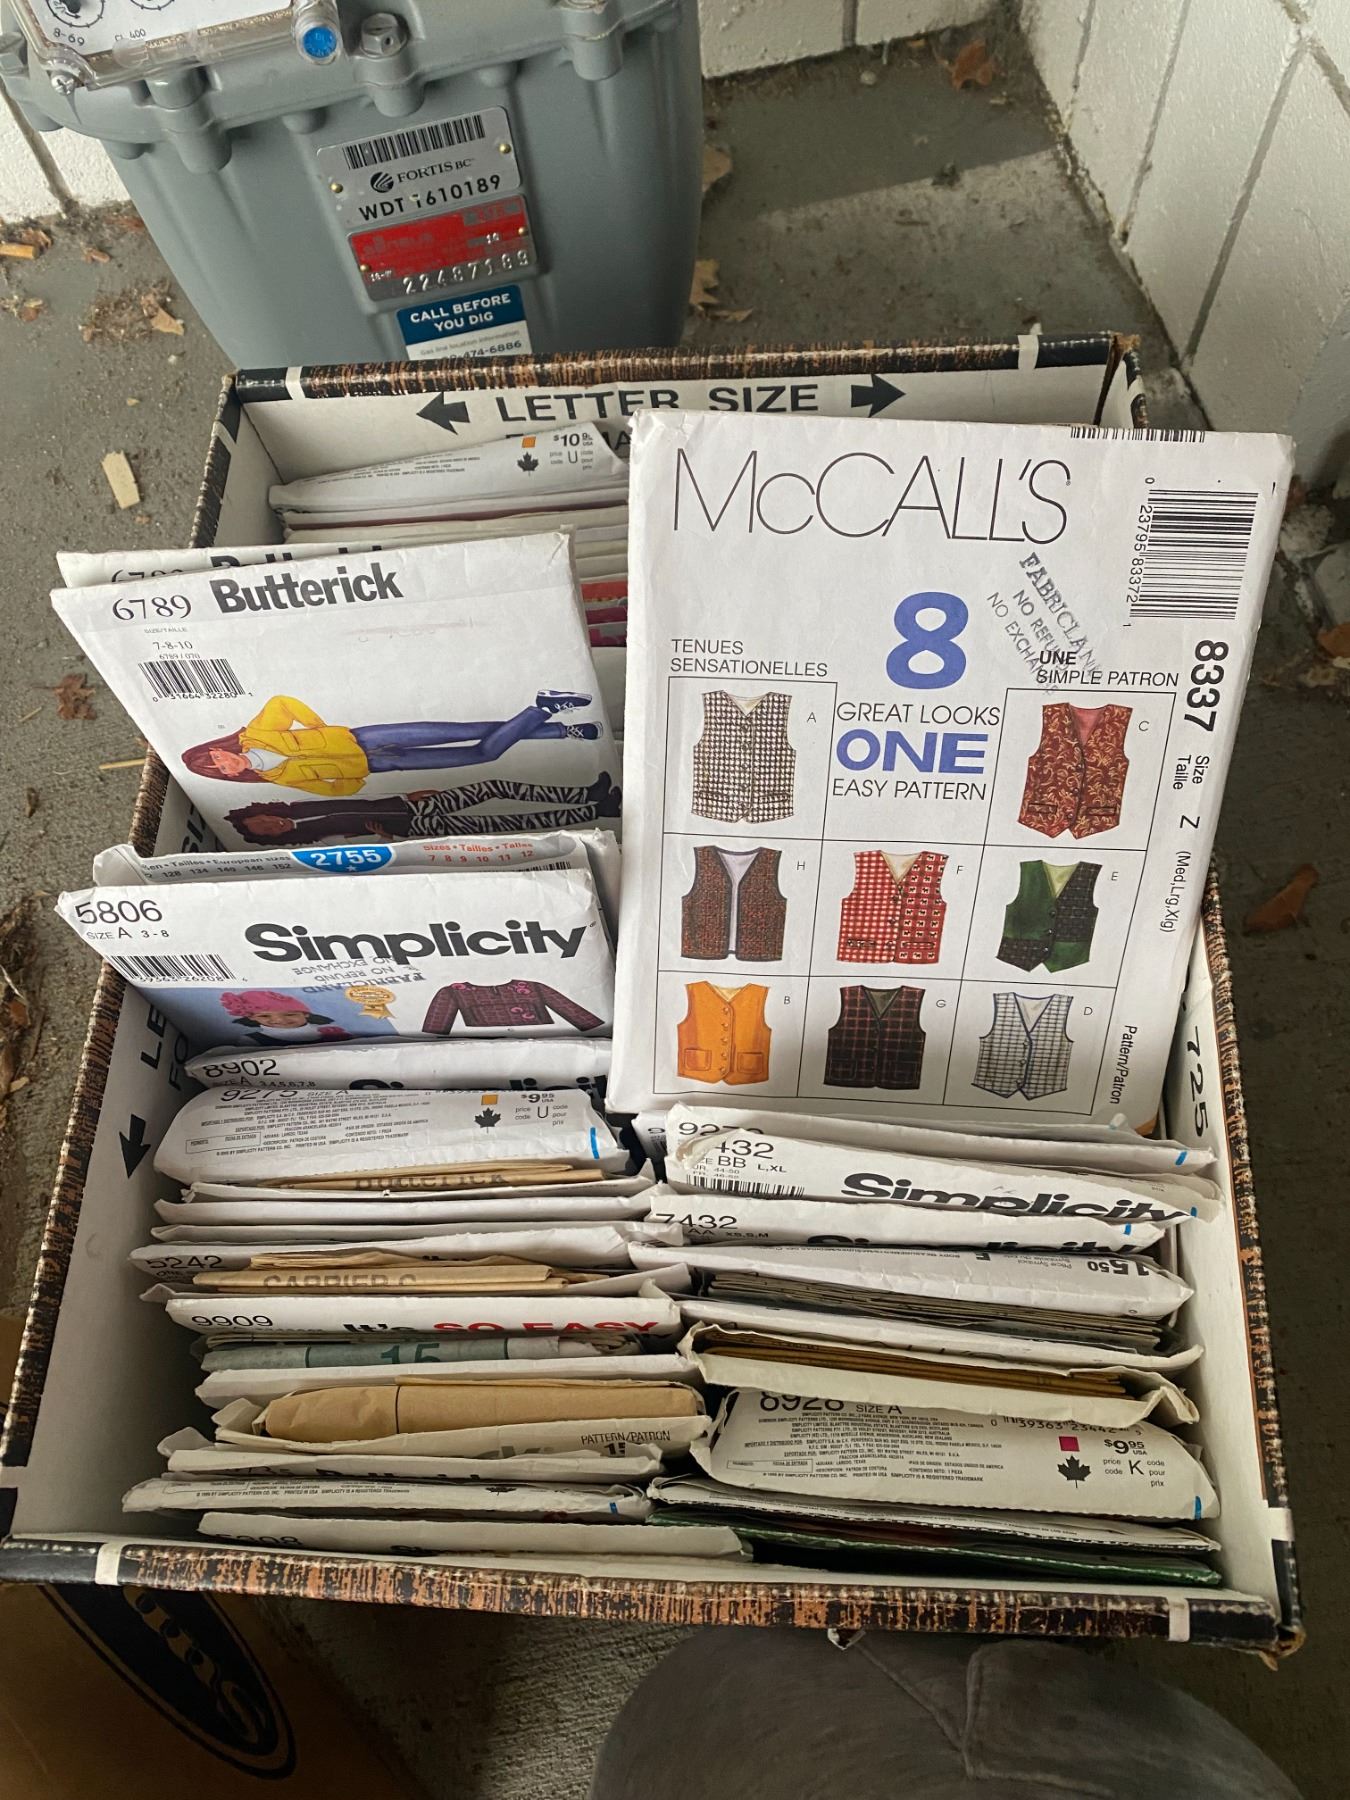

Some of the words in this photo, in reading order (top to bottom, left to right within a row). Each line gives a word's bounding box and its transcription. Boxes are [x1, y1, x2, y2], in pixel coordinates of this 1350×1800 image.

[53, 28, 85, 46] 8-69
[129, 28, 146, 39] 400
[397, 162, 453, 184] FORTIS
[455, 159, 473, 171] BC
[358, 197, 405, 221] WDT
[410, 306, 450, 323] CALL
[452, 293, 511, 318] BEFORE
[434, 317, 465, 332] YOU
[469, 311, 494, 325] DIG
[496, 388, 680, 422] LETTER
[708, 384, 819, 413] SIZE
[567, 450, 578, 464] U
[1133, 505, 1153, 551] 23795
[1126, 557, 1144, 603] 83372
[112, 594, 192, 621] 6789
[209, 562, 404, 615] Butterick
[986, 592, 1009, 617] NO
[1013, 589, 1035, 616] NO
[152, 640, 193, 650] 7-8-10
[671, 638, 744, 655] TENUES
[886, 592, 969, 690] 8
[1039, 650, 1077, 665] UNE
[670, 657, 828, 677] SENSATIONELLES
[1036, 670, 1102, 685] SIMPLE
[1107, 671, 1179, 687] PATRON
[1183, 638, 1229, 732] 8337
[807, 711, 817, 723] A
[836, 701, 914, 723] GREAT
[920, 704, 1000, 726] LOOKS
[1138, 720, 1150, 732] C
[836, 729, 989, 774] ONE
[1172, 754, 1192, 791] Taille
[1191, 754, 1210, 786] Size
[832, 778, 889, 798] EASY
[894, 780, 986, 801] PATTERN
[1179, 814, 1200, 829] Z
[443, 855, 452, 863] 8
[459, 855, 467, 863] 9
[476, 855, 490, 863] 10
[498, 853, 511, 861] 11
[521, 850, 533, 858] 12
[460, 844, 493, 852] Tailles
[212, 857, 263, 866] European
[310, 848, 382, 867] 2755
[796, 861, 806, 871] H
[956, 865, 964, 875] F
[1111, 871, 1119, 882] E
[75, 900, 163, 924] 5806
[86, 931, 114, 940] SIZE
[118, 927, 132, 939] A
[245, 919, 589, 965] Simplicity
[291, 958, 368, 975] EXCHANGE
[370, 966, 395, 975] NO
[314, 969, 367, 983] REFUND
[783, 995, 791, 1005] B
[935, 999, 946, 1009] G
[1083, 1006, 1093, 1016] D
[203, 1058, 281, 1077] 8902
[1108, 1024, 1138, 1105] Pattern/Patron
[537, 1106, 549, 1119] U
[679, 1122, 764, 1136] 92
[715, 1140, 774, 1159] 432
[718, 1155, 746, 1168] BB
[758, 1164, 787, 1173] L,XL
[841, 1172, 1193, 1221] Simplicity
[655, 1213, 738, 1230] 7432
[688, 1228, 714, 1236] AA
[146, 1255, 228, 1269] 5242
[191, 1315, 273, 1327] 9909
[343, 1323, 415, 1332] It'
[434, 1322, 504, 1332] SO
[522, 1321, 659, 1332] EASY
[856, 1404, 884, 1414] SIZE
[888, 1405, 902, 1414] A
[990, 1419, 998, 1427] 0
[1018, 1418, 1063, 1430] 39363
[580, 1430, 671, 1446] PATTERN/PATRON
[1103, 1458, 1121, 1466] price
[1128, 1460, 1145, 1476] K
[1149, 1469, 1166, 1477] pour
[1150, 1479, 1164, 1487] prix
